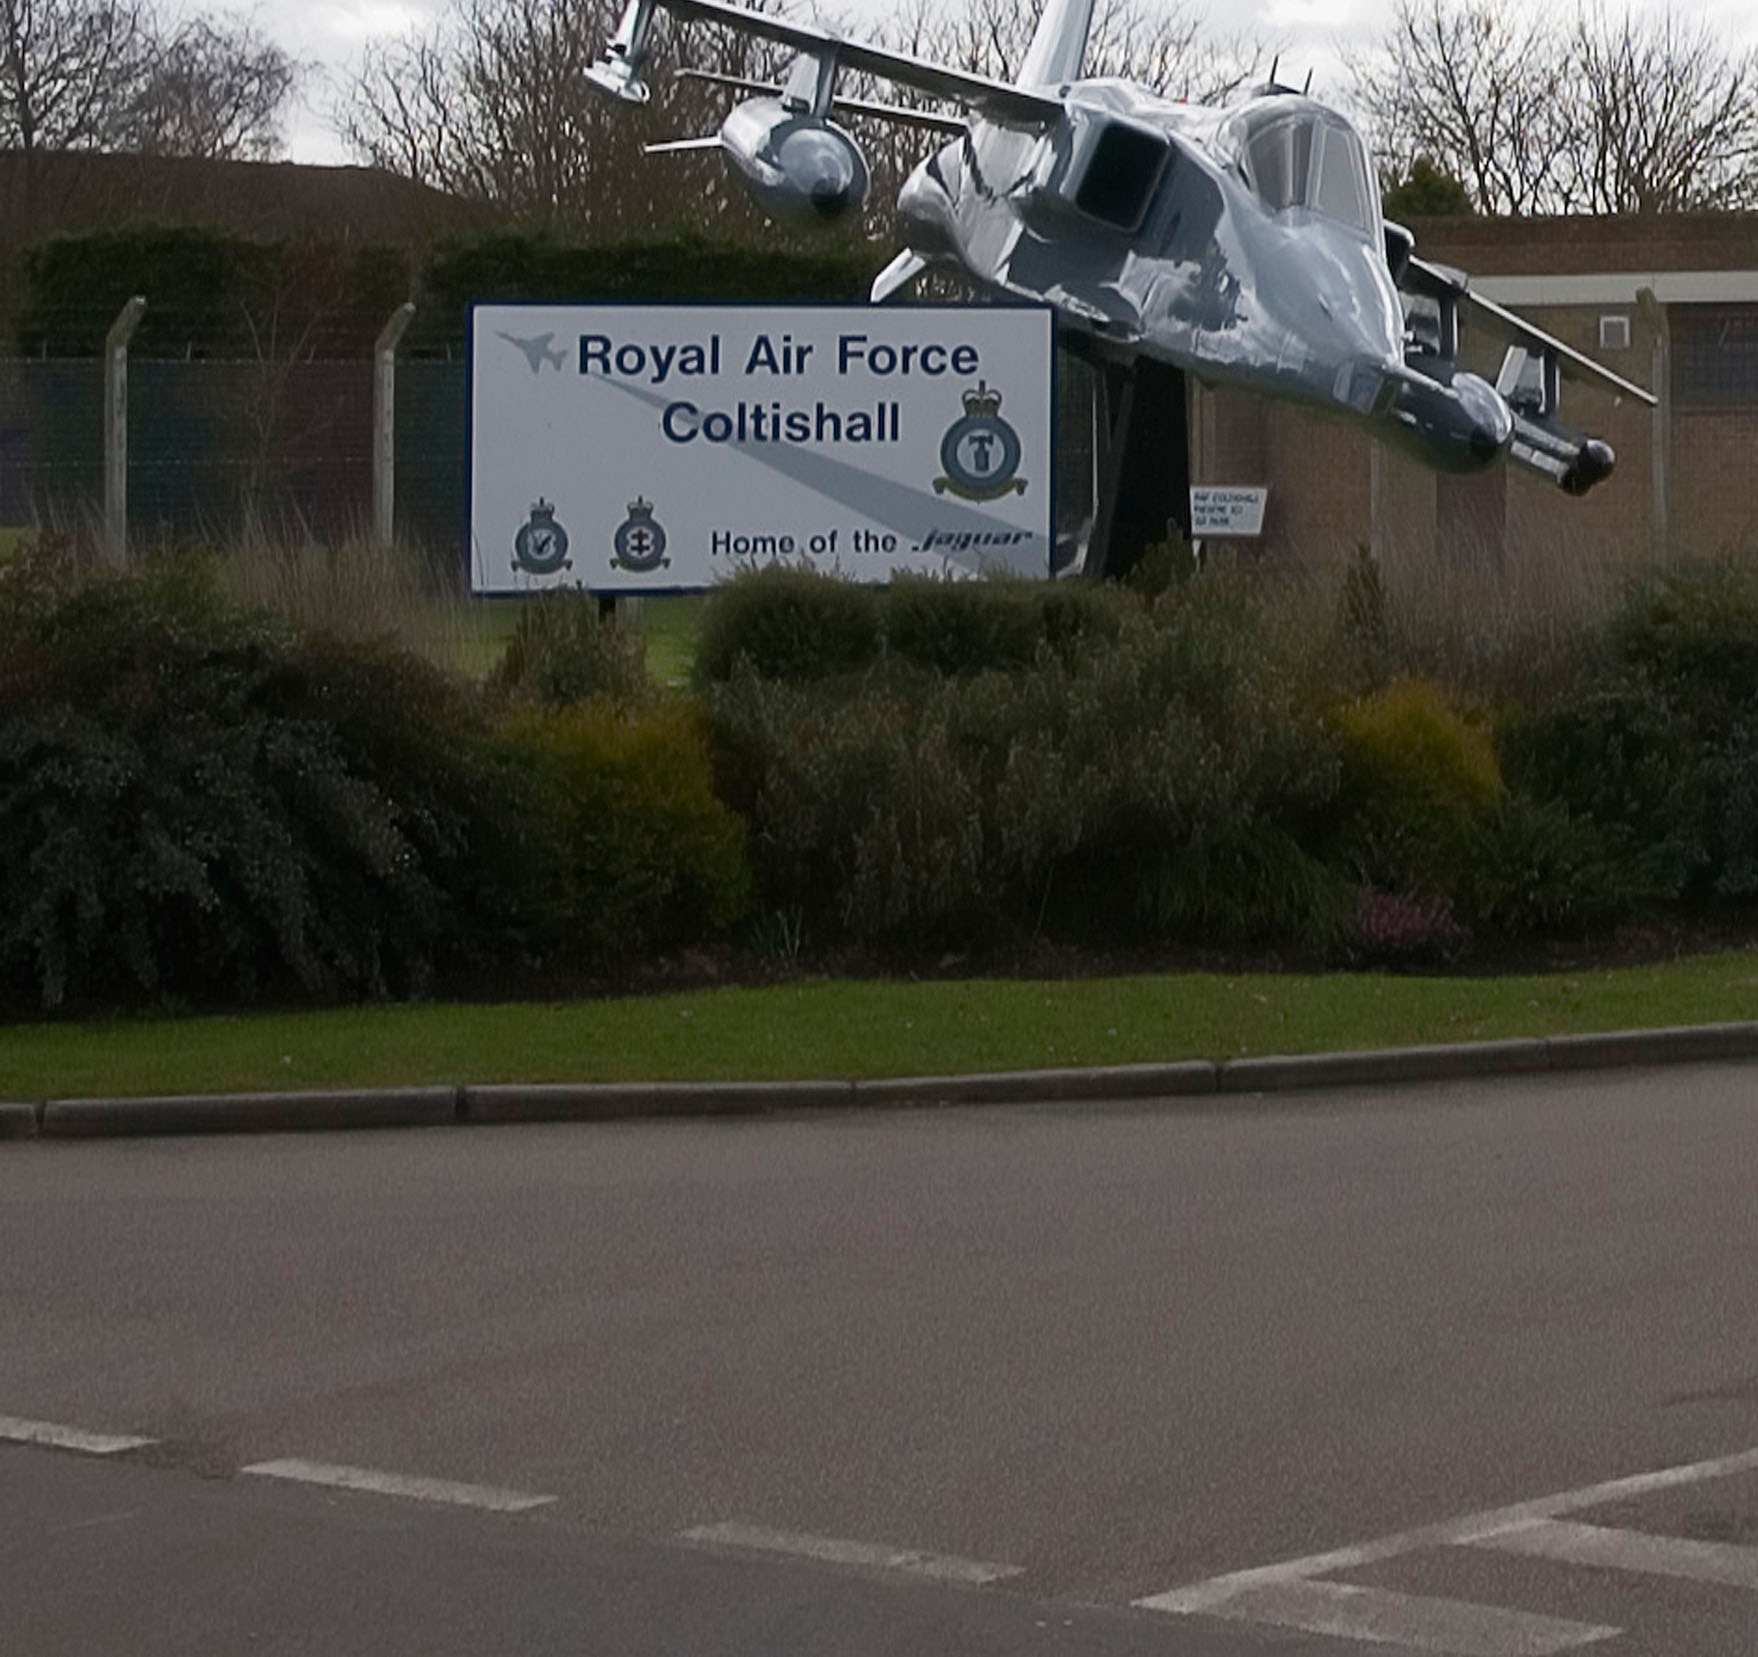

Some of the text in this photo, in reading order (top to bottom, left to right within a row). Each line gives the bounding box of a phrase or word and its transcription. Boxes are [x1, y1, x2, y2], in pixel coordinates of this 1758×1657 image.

[578, 335, 979, 383] Royal Air Force
[662, 401, 899, 444] Coltishall
[711, 530, 795, 555] Home
[809, 530, 838, 554] of
[853, 530, 897, 554] the
